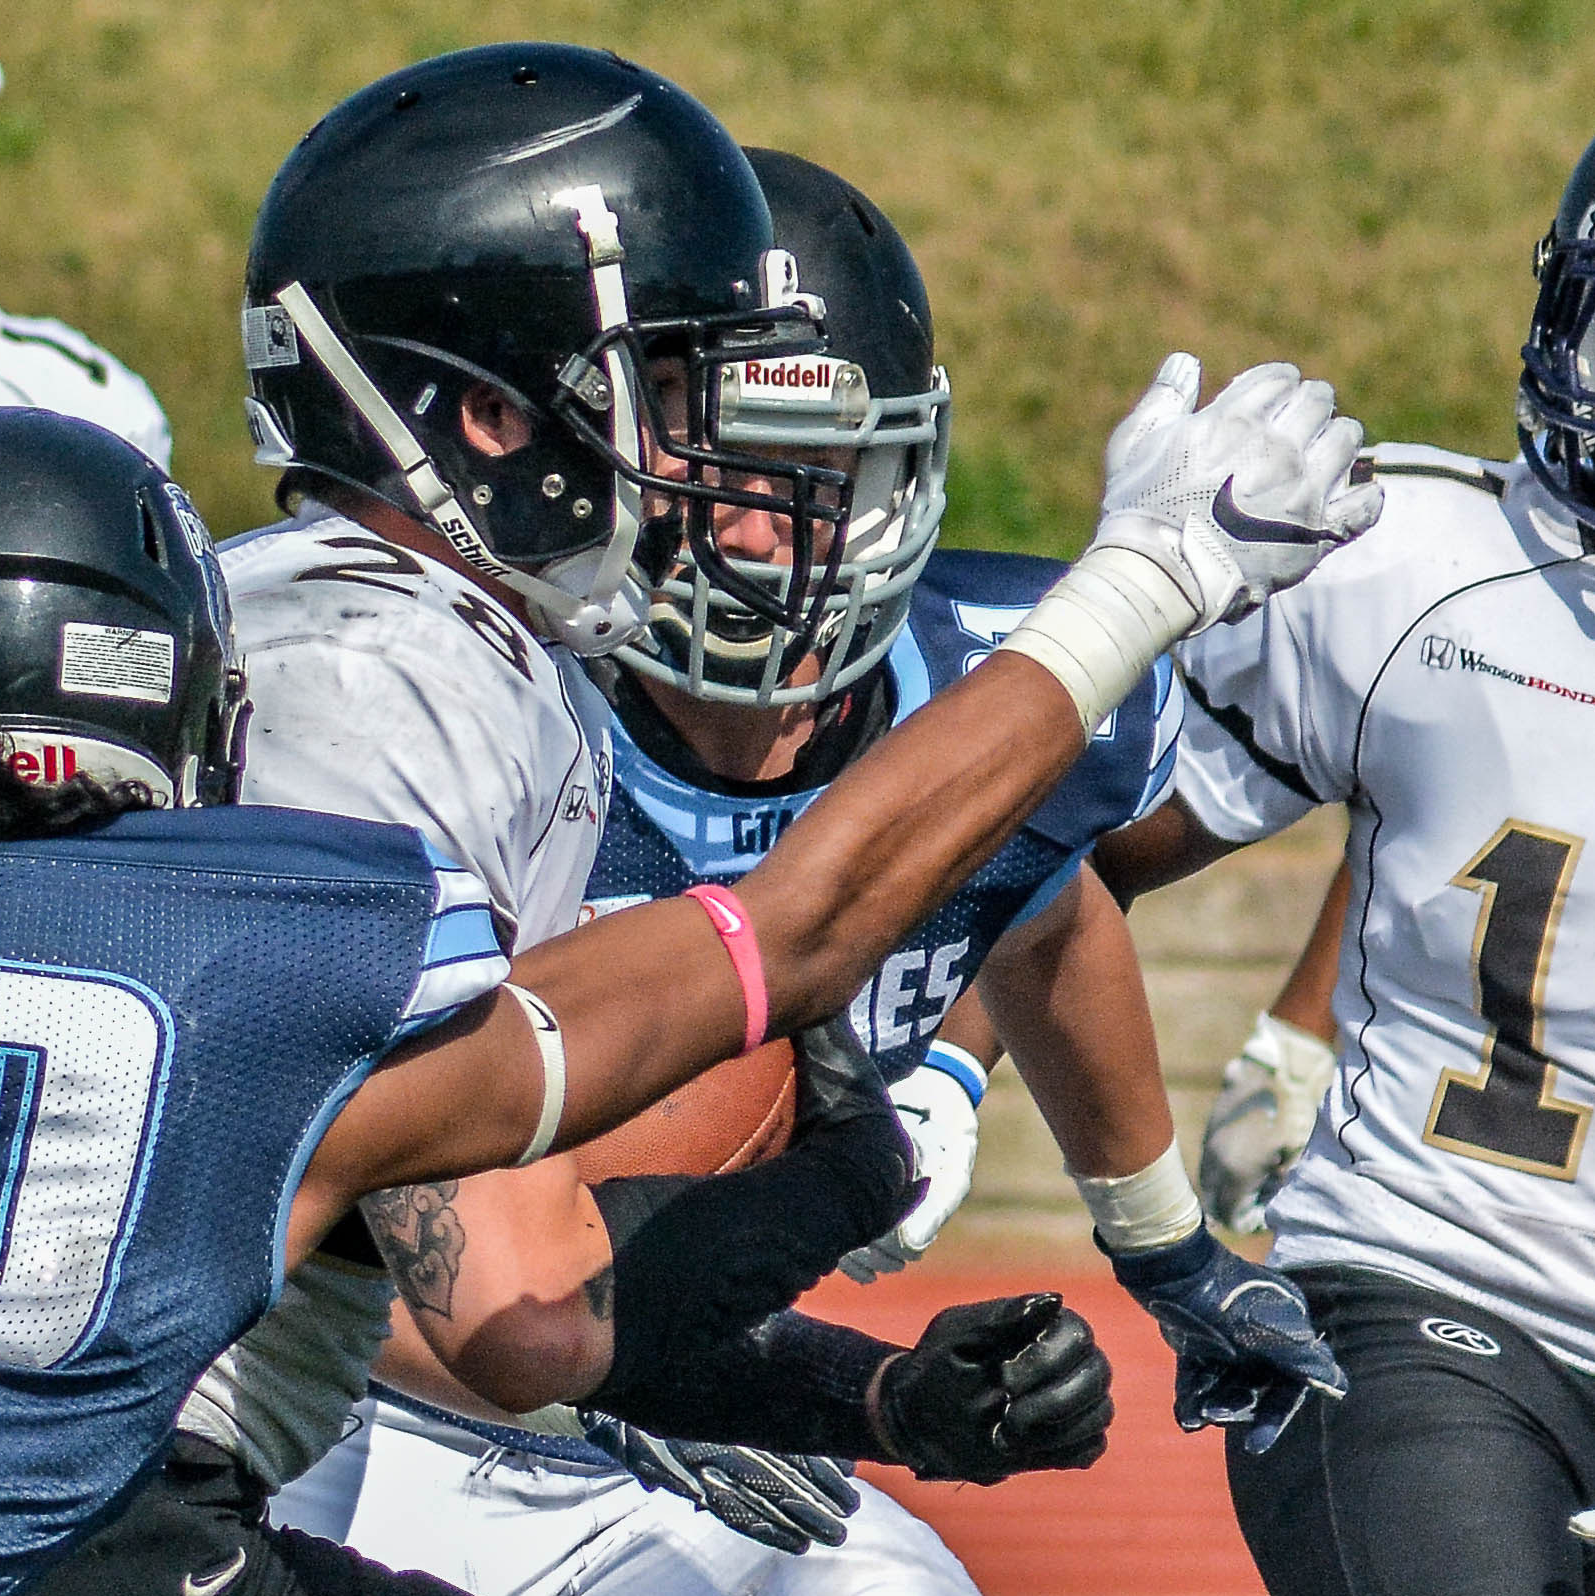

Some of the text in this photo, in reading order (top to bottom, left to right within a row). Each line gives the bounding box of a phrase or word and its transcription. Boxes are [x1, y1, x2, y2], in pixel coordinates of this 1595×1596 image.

[745, 360, 831, 388] Riddell
[291, 536, 536, 685] 28
[1422, 817, 1593, 1182] 1
